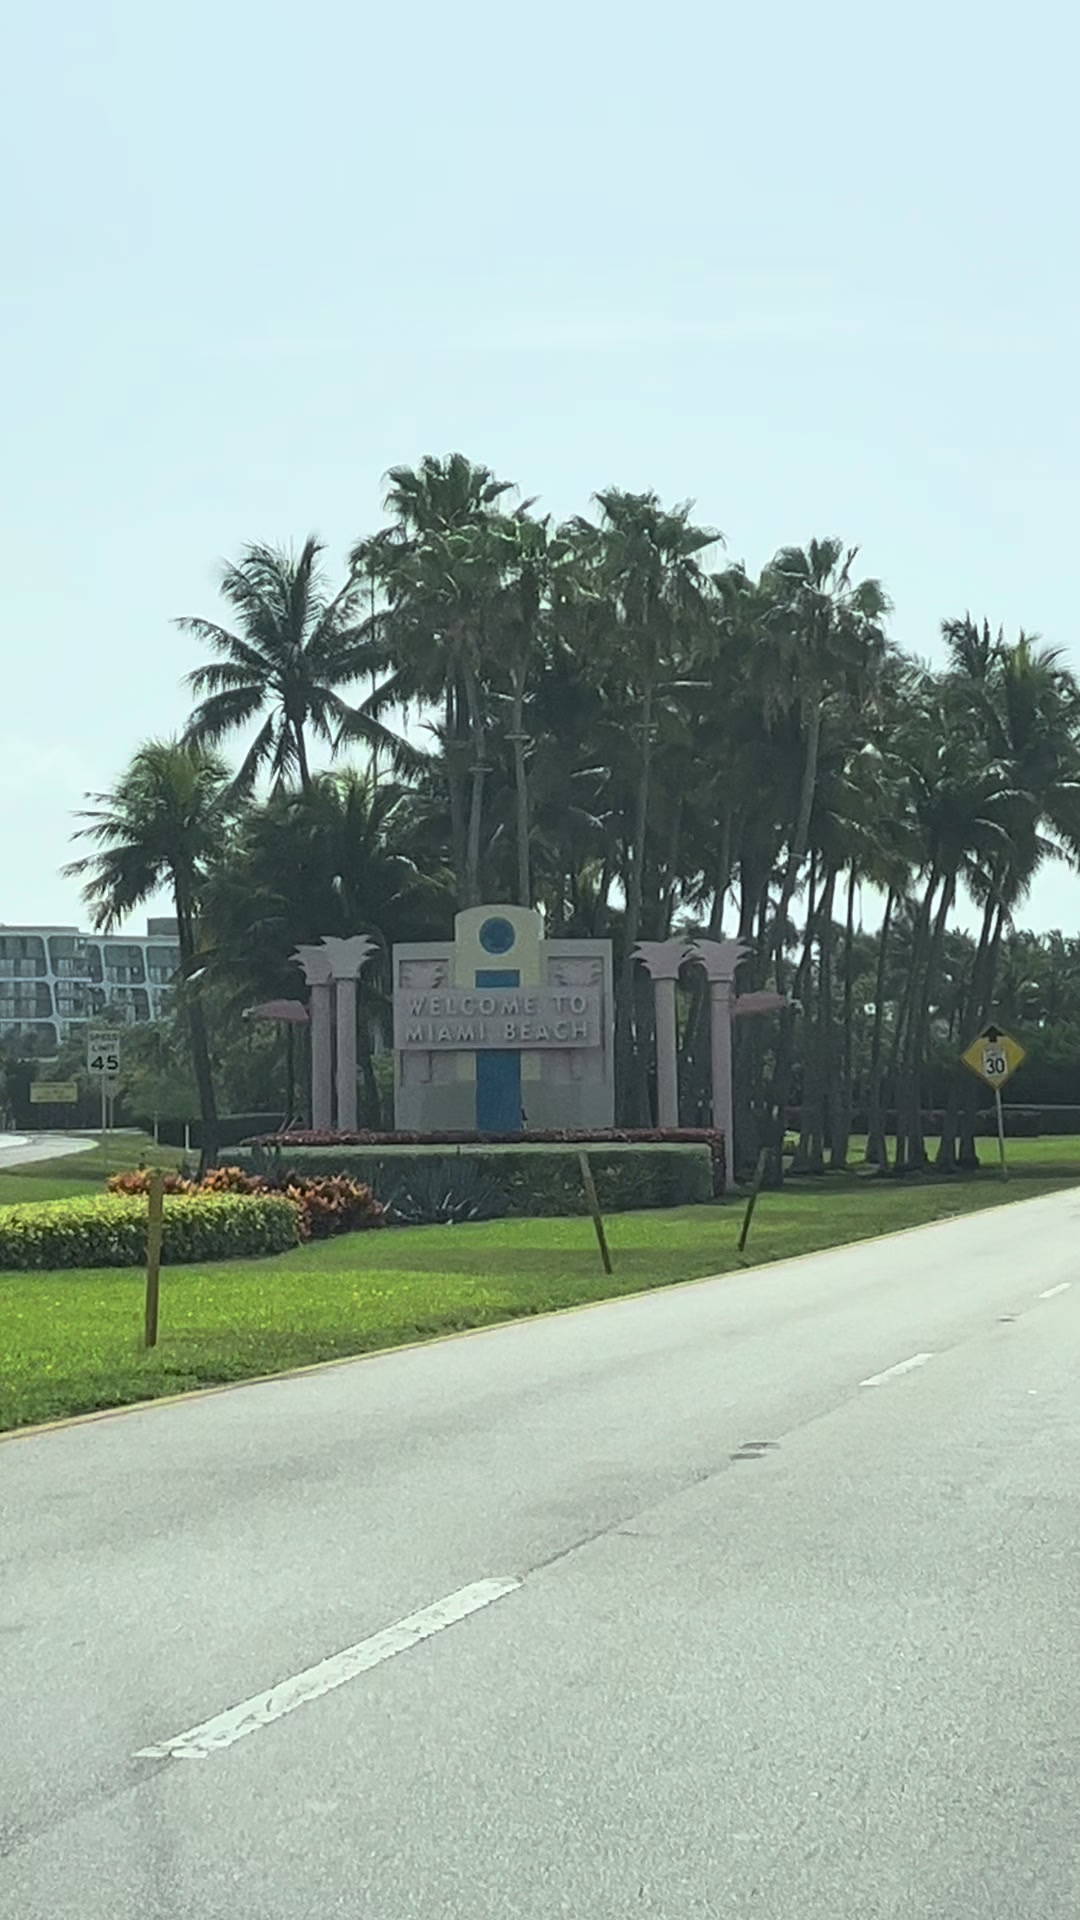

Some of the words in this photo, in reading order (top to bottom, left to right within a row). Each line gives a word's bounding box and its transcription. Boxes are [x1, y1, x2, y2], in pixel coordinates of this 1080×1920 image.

[409, 997, 537, 1016] WELCOME
[553, 994, 587, 1014] TO
[405, 1022, 485, 1042] MIAMI
[503, 1021, 588, 1041] BEACH
[91, 1055, 118, 1070] 45
[986, 1058, 1005, 1074] 30
